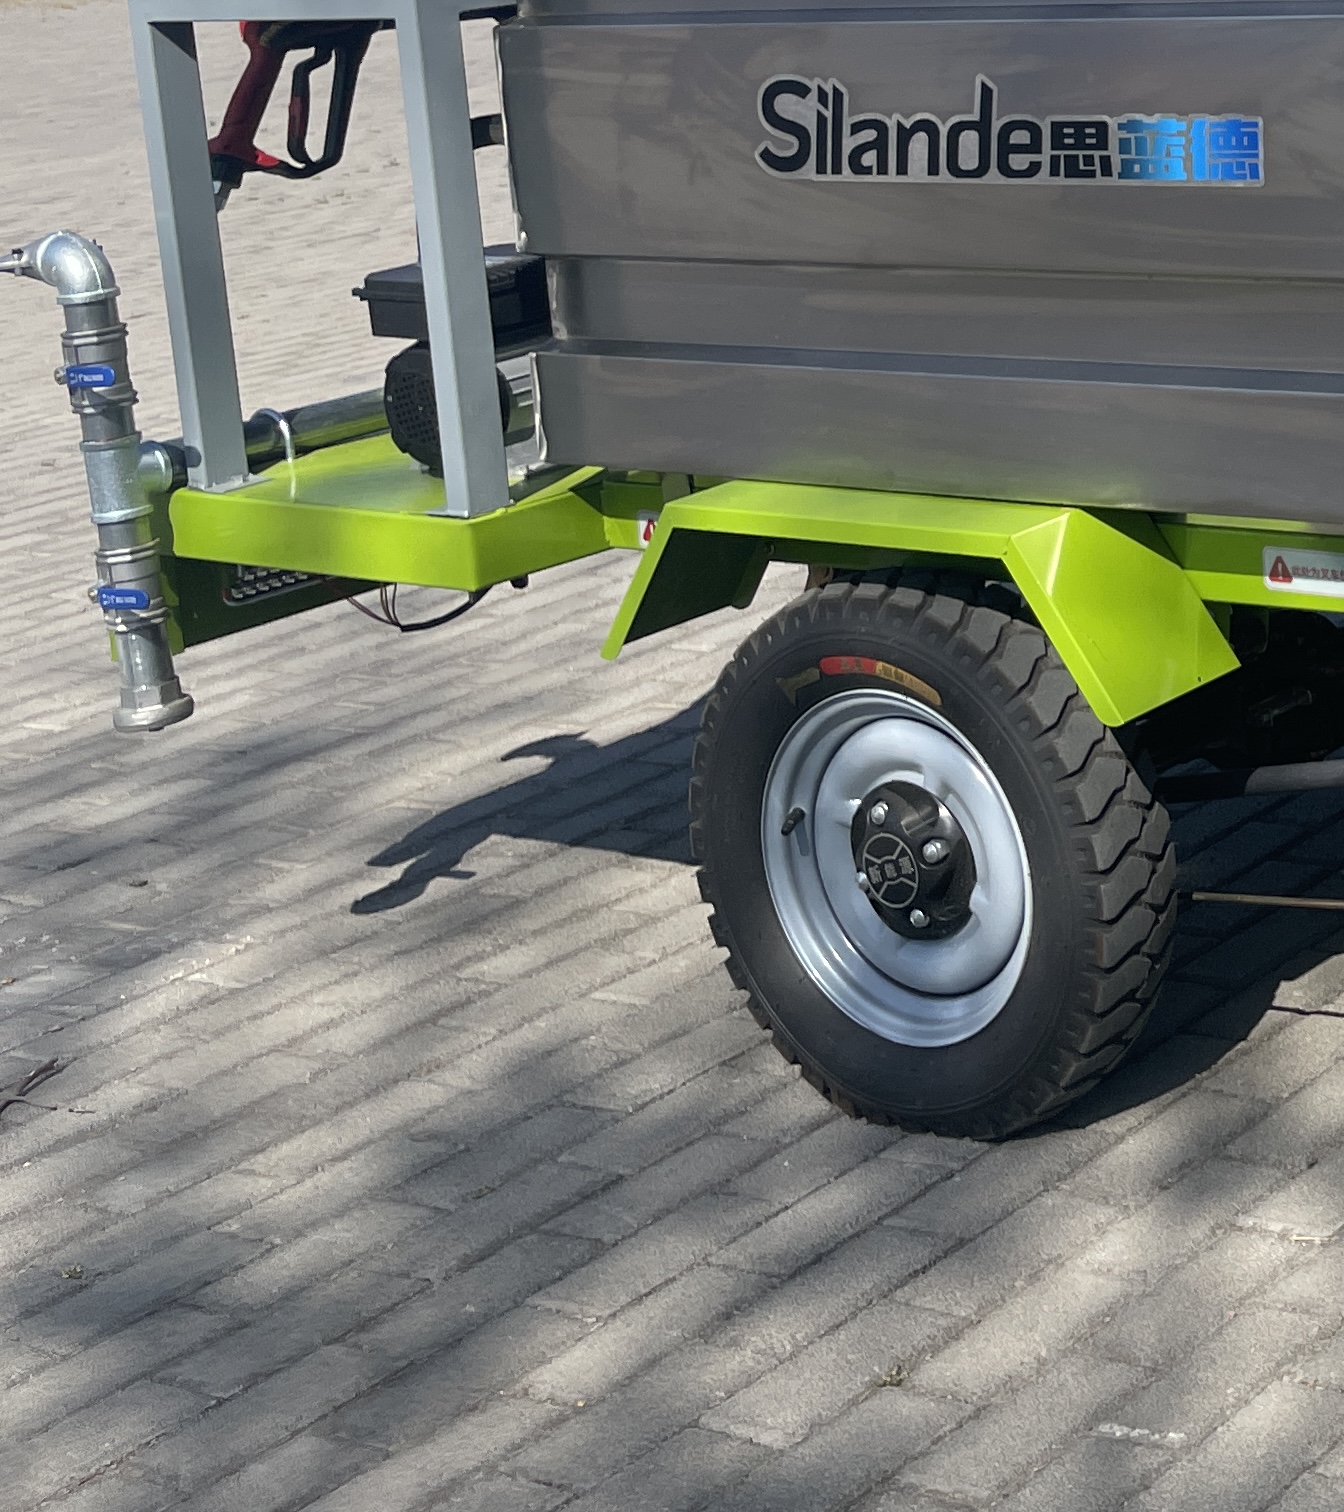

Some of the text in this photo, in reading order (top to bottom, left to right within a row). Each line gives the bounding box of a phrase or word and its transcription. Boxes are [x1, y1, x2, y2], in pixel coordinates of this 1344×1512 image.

[759, 78, 1261, 182] Silande 思蓝德
[867, 855, 914, 885] 新能源
